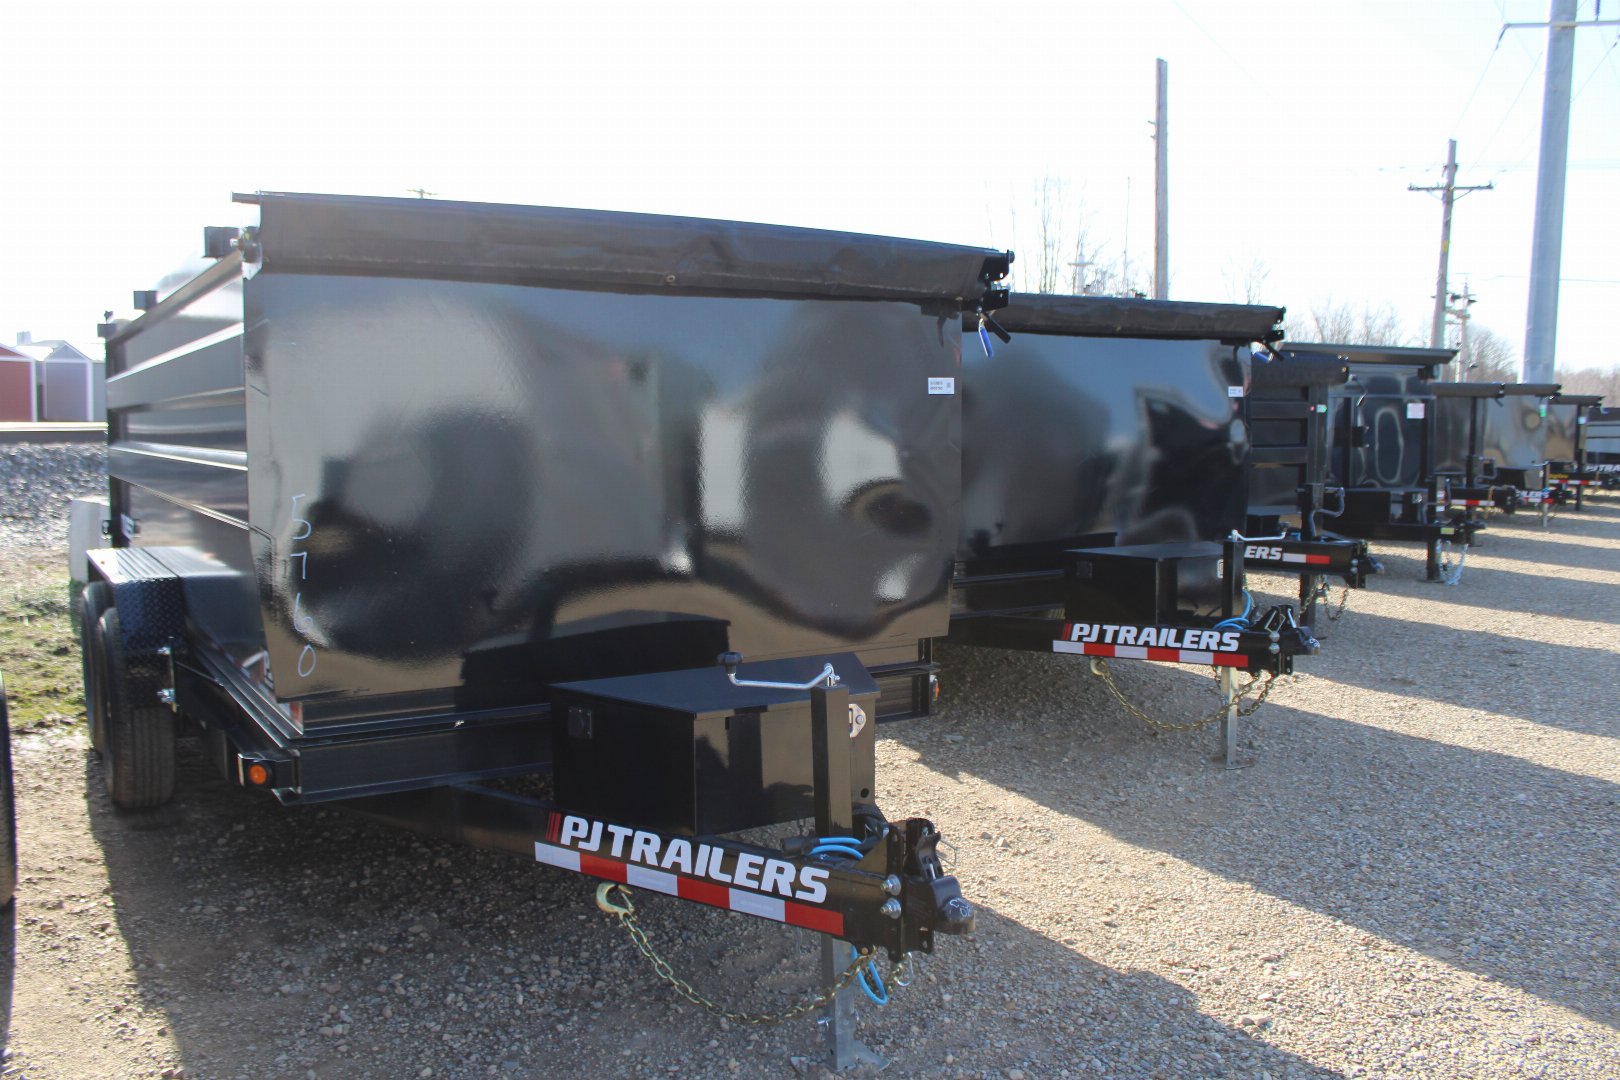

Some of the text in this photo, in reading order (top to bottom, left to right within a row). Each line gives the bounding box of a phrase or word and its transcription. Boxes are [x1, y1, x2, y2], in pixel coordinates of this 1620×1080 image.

[1070, 623, 1240, 652] PJ TRAILERS
[560, 815, 830, 904] PJ TRAILERS
